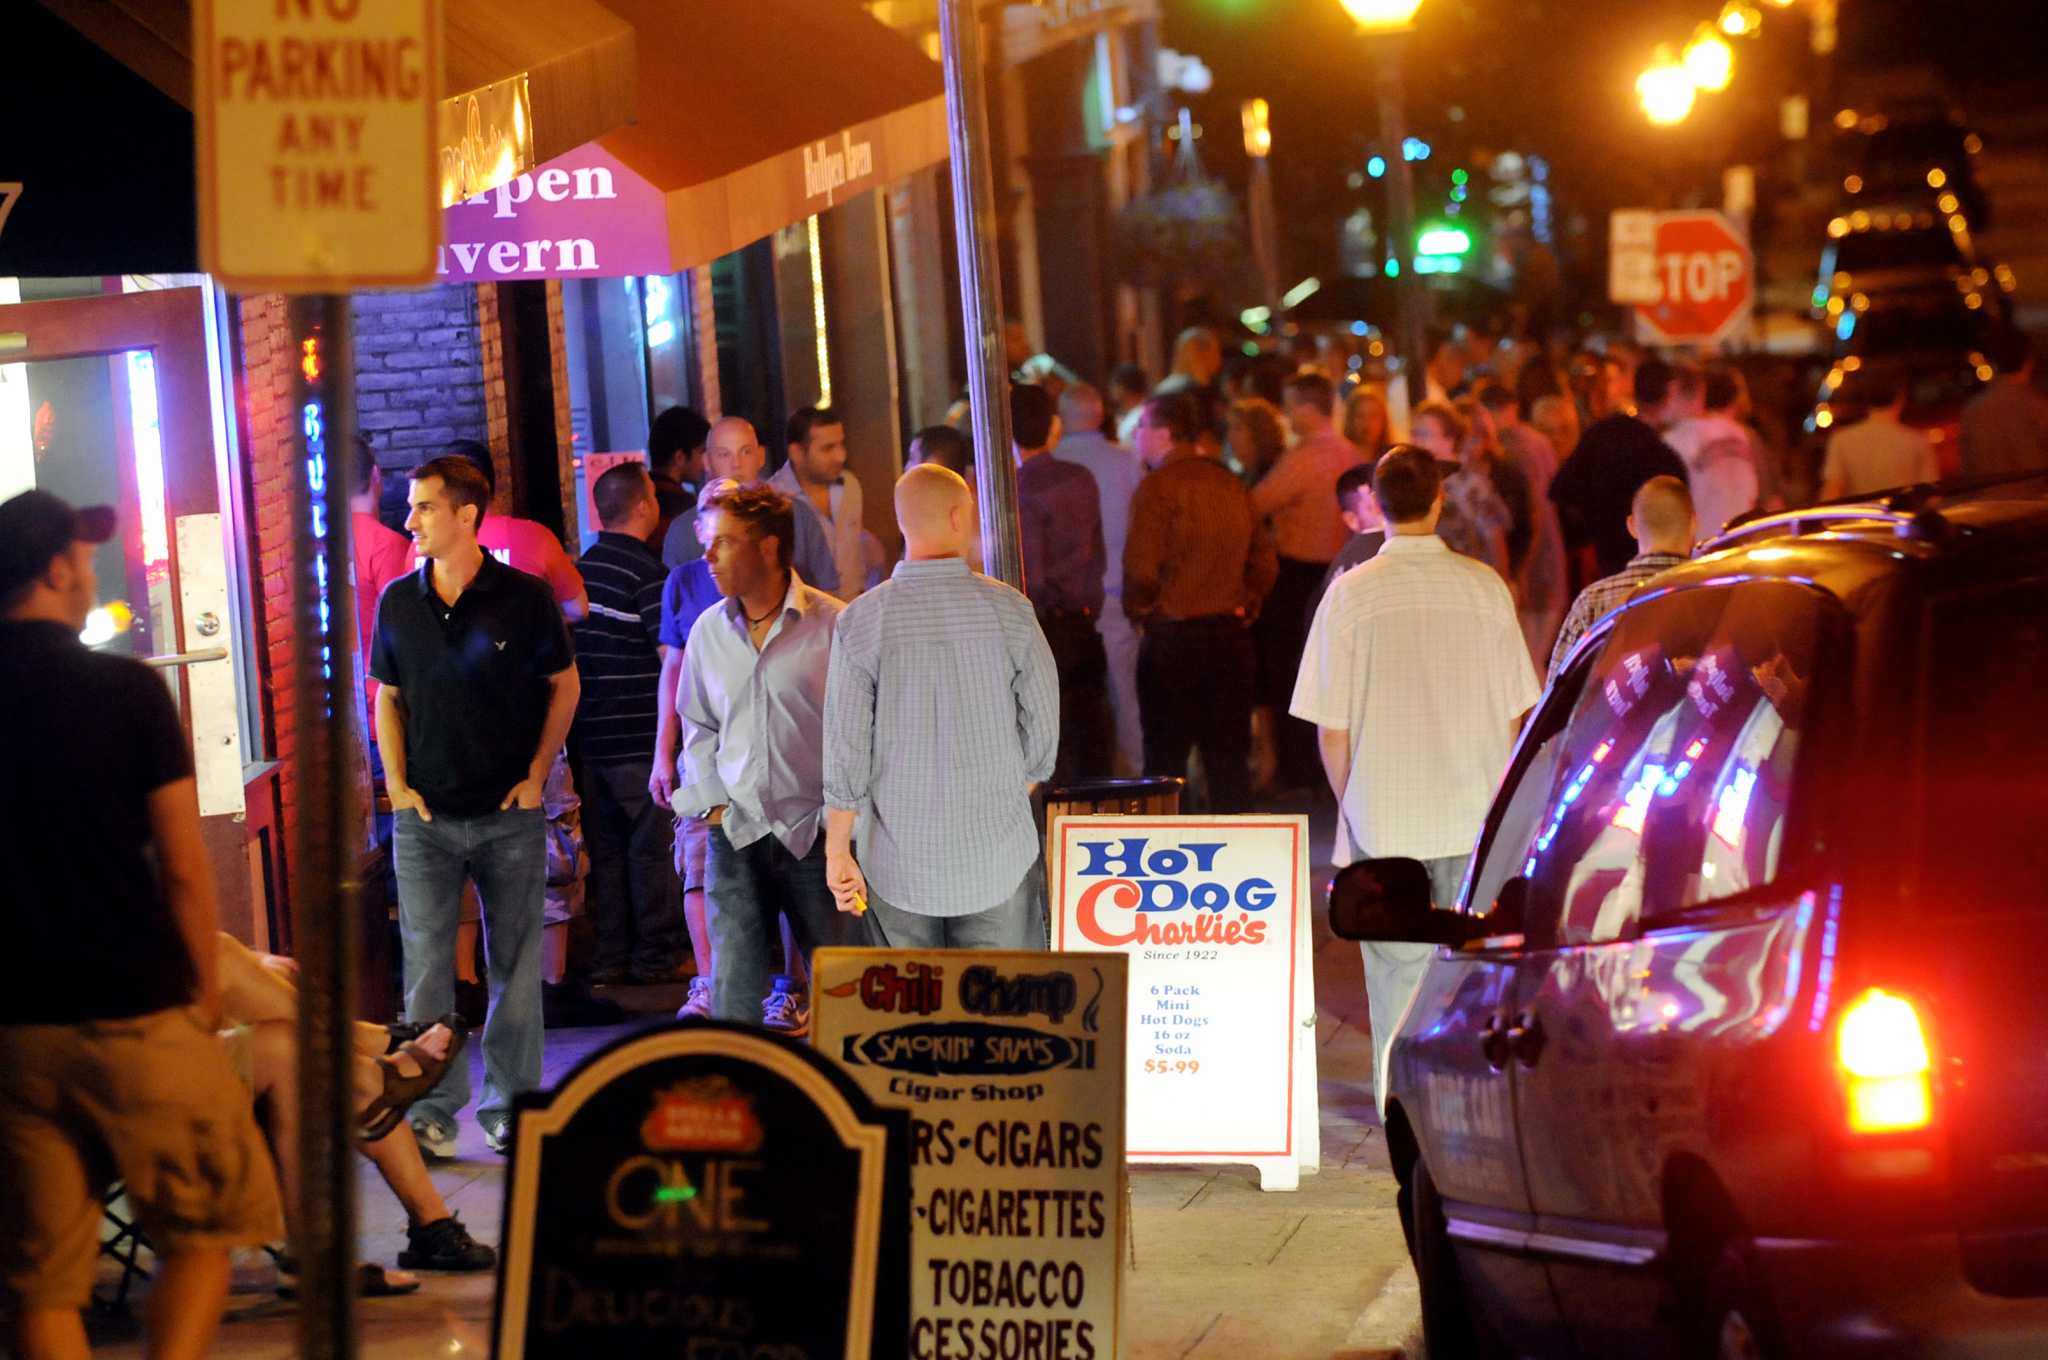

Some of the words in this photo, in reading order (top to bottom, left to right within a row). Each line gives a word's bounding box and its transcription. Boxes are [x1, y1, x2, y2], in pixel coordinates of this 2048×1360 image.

[221, 37, 423, 101] PARKING
[276, 114, 366, 152] ANY
[269, 166, 379, 211] TIME
[453, 166, 618, 218] pen
[1077, 838, 1228, 877] HOT
[1076, 878, 1267, 946] Charlie's
[1136, 877, 1277, 913] DOG
[1144, 951, 1179, 960] Since
[1185, 951, 1218, 960] 1922
[860, 961, 944, 1016] Chili
[1150, 985, 1159, 995] 6
[1164, 985, 1200, 996] Pack
[1156, 1000, 1190, 1010] Mini
[1140, 1014, 1167, 1025] Hot
[1172, 1014, 1209, 1027] Dogs
[1154, 1031, 1170, 1040] 16
[1175, 1031, 1191, 1040] oz
[984, 1035, 1055, 1065] SAM'S
[1144, 1058, 1200, 1074] $5.99
[1155, 1044, 1192, 1055] Soda
[888, 1076, 965, 1102] Cigar
[971, 1082, 1044, 1102] Shop
[928, 1259, 1085, 1309] TOBACCO
[911, 1316, 1096, 1360] CESSORIES
